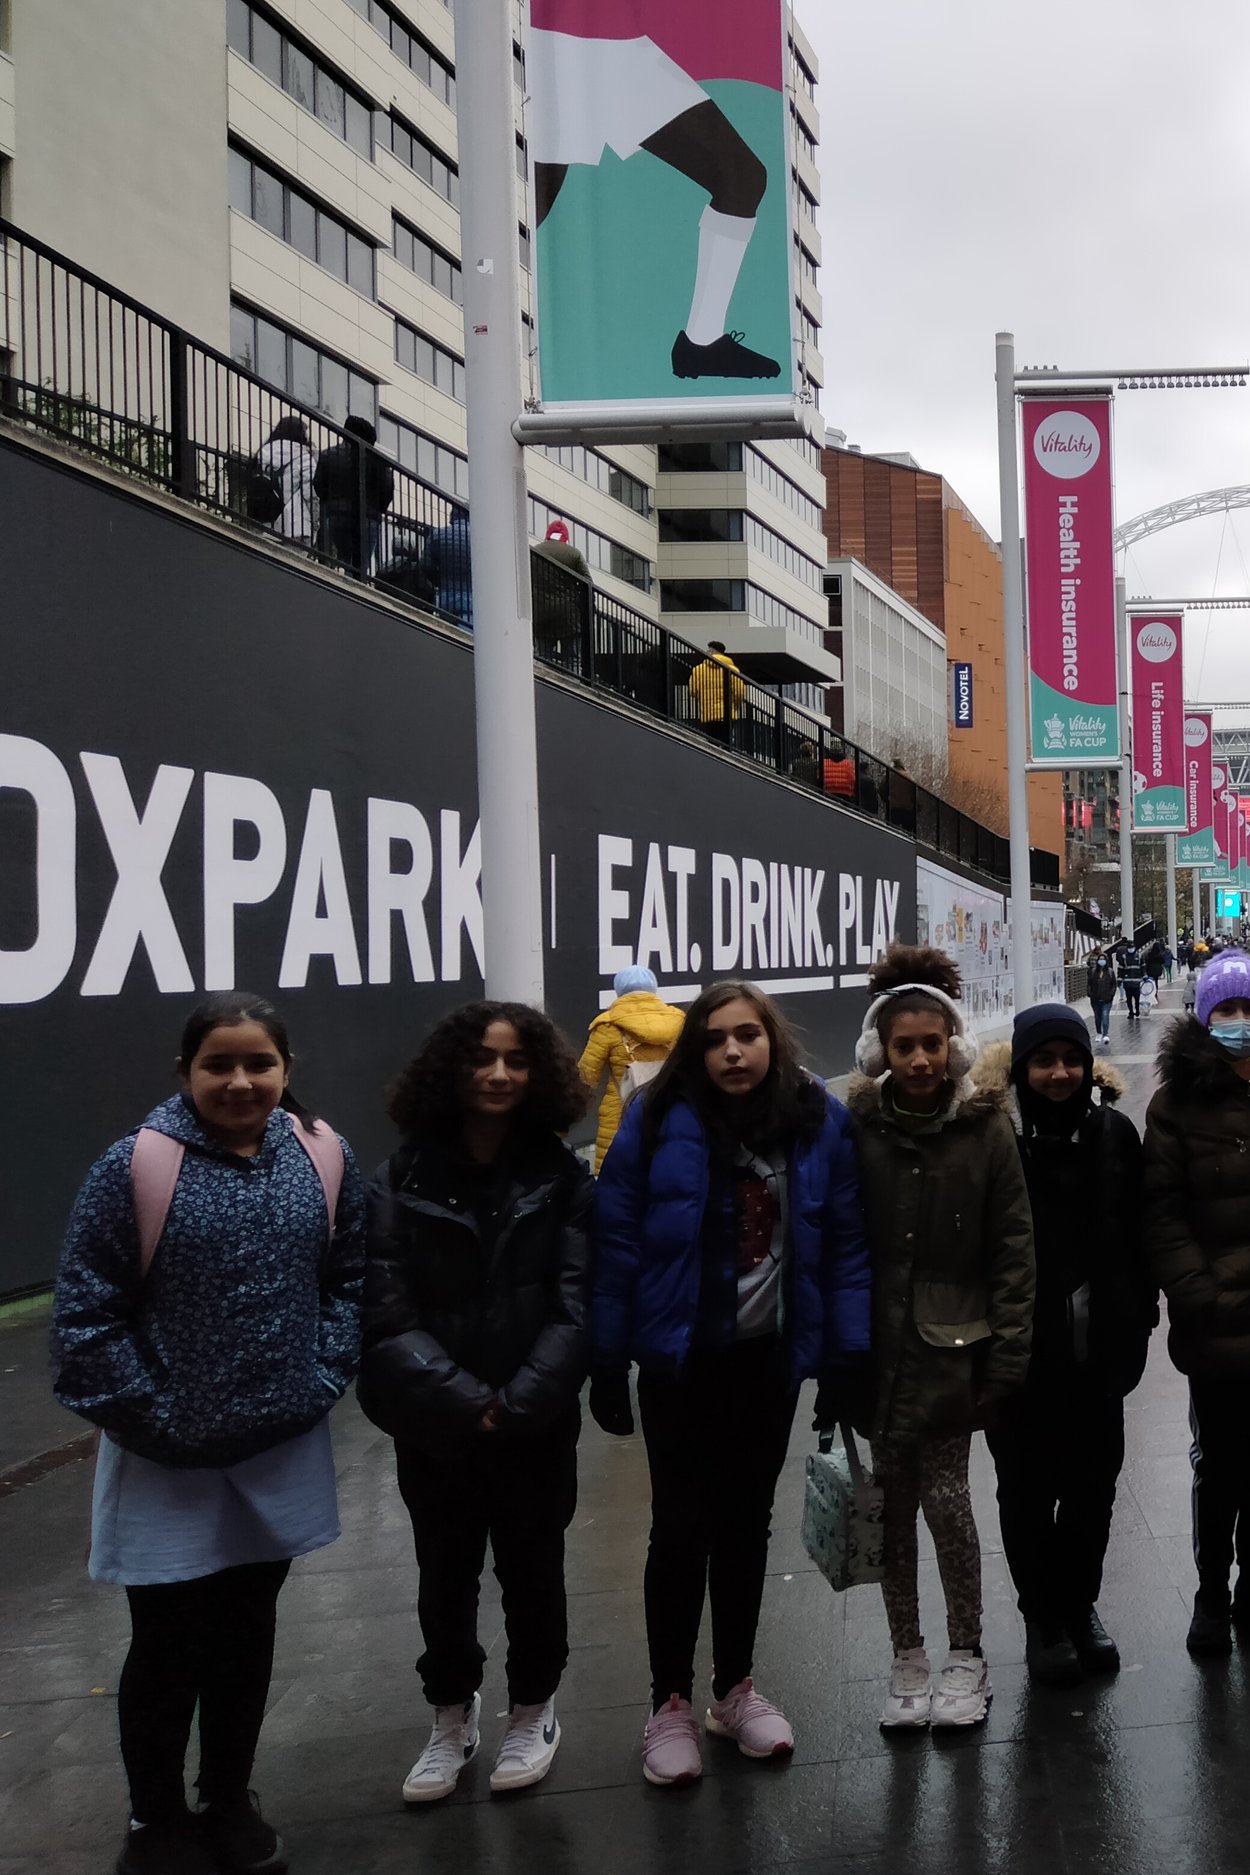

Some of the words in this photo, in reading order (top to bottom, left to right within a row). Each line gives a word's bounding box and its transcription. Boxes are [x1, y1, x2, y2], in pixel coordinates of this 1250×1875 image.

[1040, 431, 1092, 459] Vitality
[1058, 495, 1080, 573] Health
[1061, 578, 1081, 691] insurance
[1141, 633, 1173, 651] Vitality
[959, 666, 969, 720] NOVOTEL
[1151, 681, 1164, 708] Life
[1068, 713, 1106, 735] Vitality
[1069, 738, 1083, 747] FA
[1084, 737, 1107, 747] CUP
[1151, 709, 1164, 778] insurance
[1189, 760, 1199, 780] Car
[1190, 780, 1199, 828] insurance
[598, 834, 701, 975] EAT.
[712, 852, 833, 970] DRINK.
[839, 873, 900, 965] PLAY
